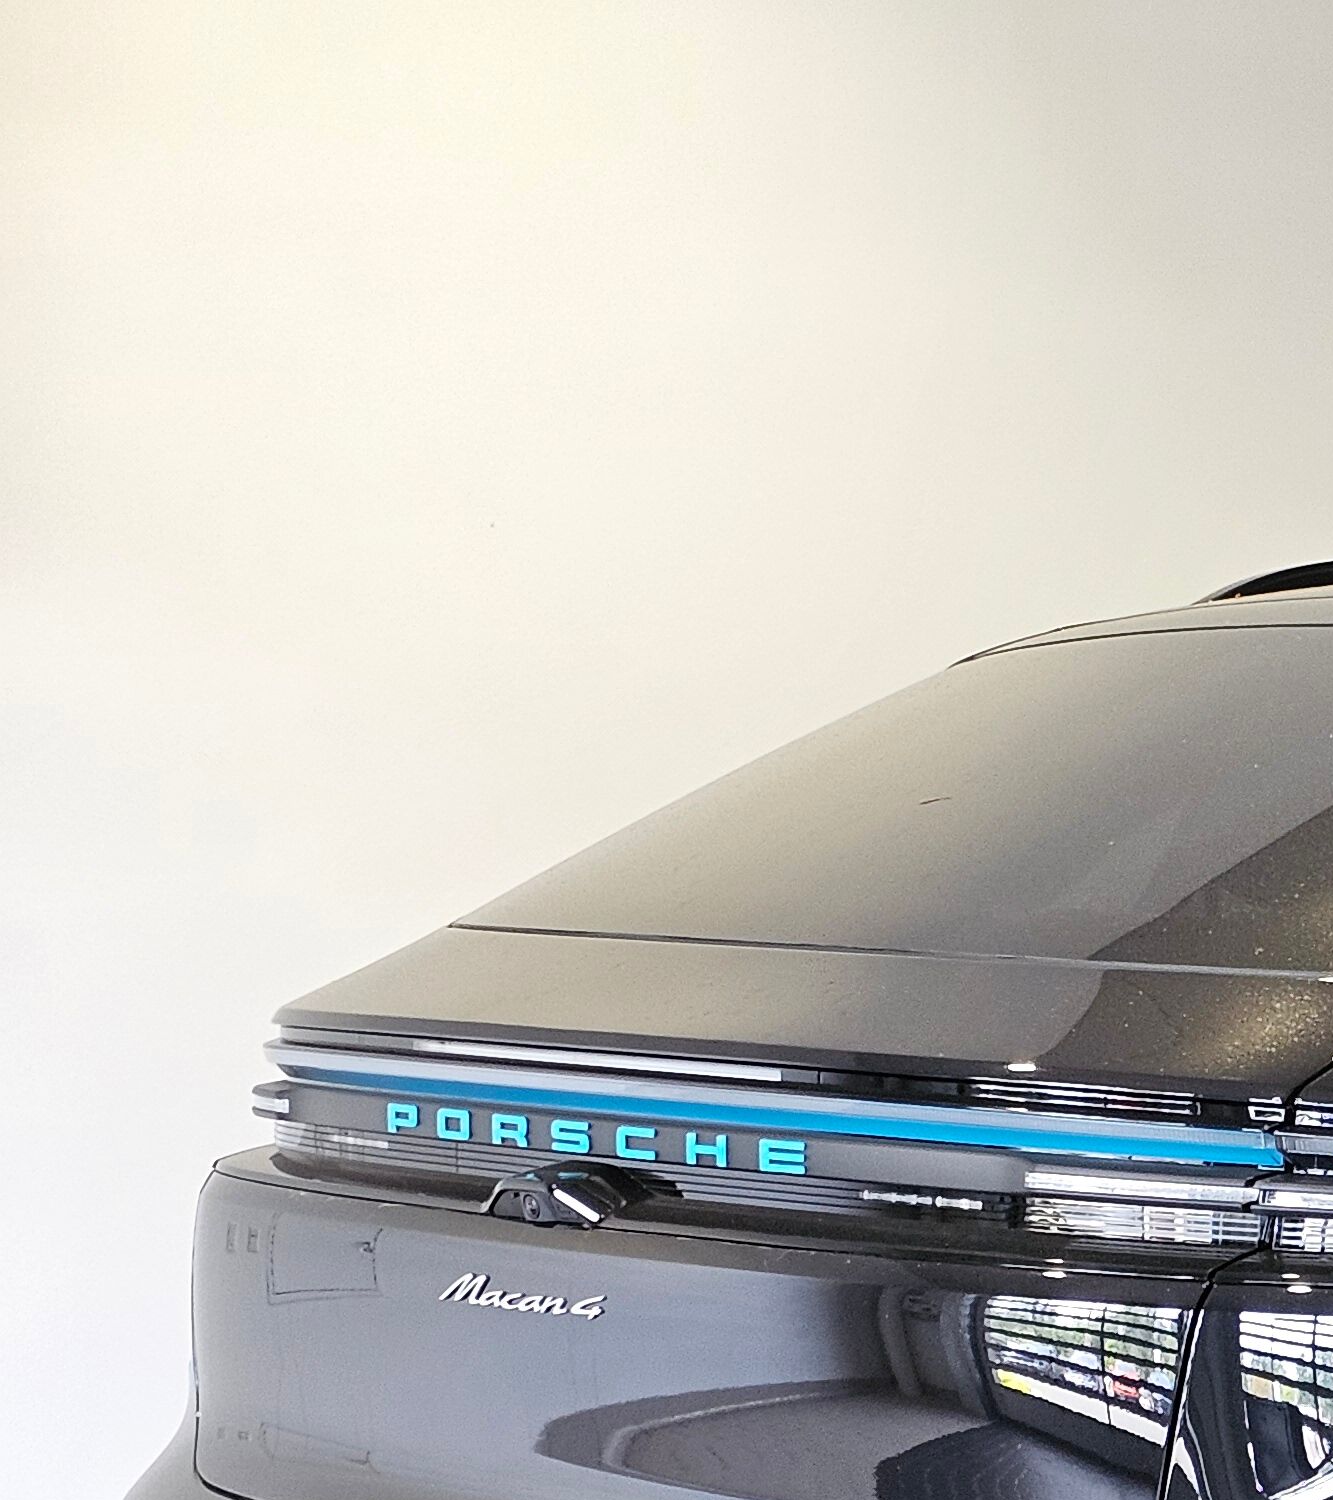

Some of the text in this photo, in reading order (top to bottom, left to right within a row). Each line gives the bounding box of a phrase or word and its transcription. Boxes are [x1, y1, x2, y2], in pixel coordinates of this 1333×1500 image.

[387, 1102, 807, 1174] PORSCHE
[439, 1272, 606, 1320] Macan 4
